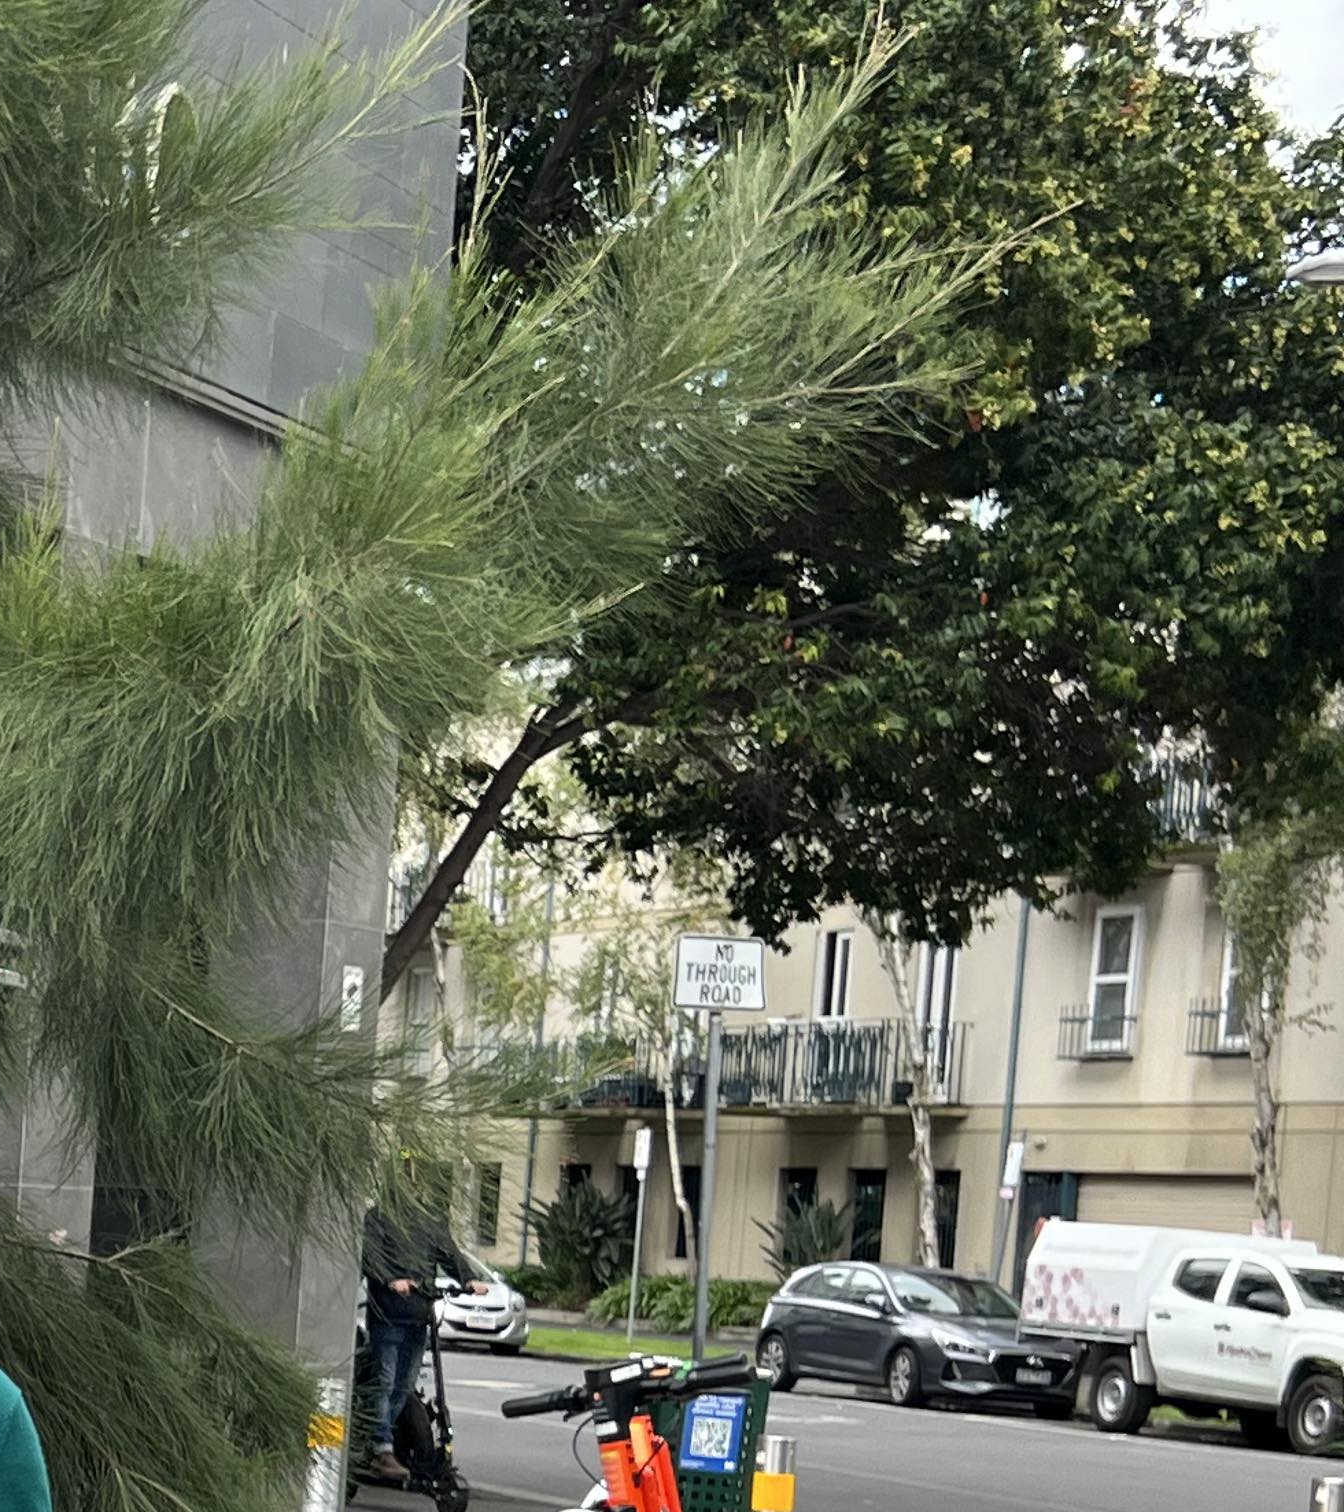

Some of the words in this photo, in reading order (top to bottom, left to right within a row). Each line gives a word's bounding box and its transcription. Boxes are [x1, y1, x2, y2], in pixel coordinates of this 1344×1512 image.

[715, 944, 735, 963] NO
[686, 962, 757, 985] THROUGH
[699, 984, 742, 1004] ROAD
